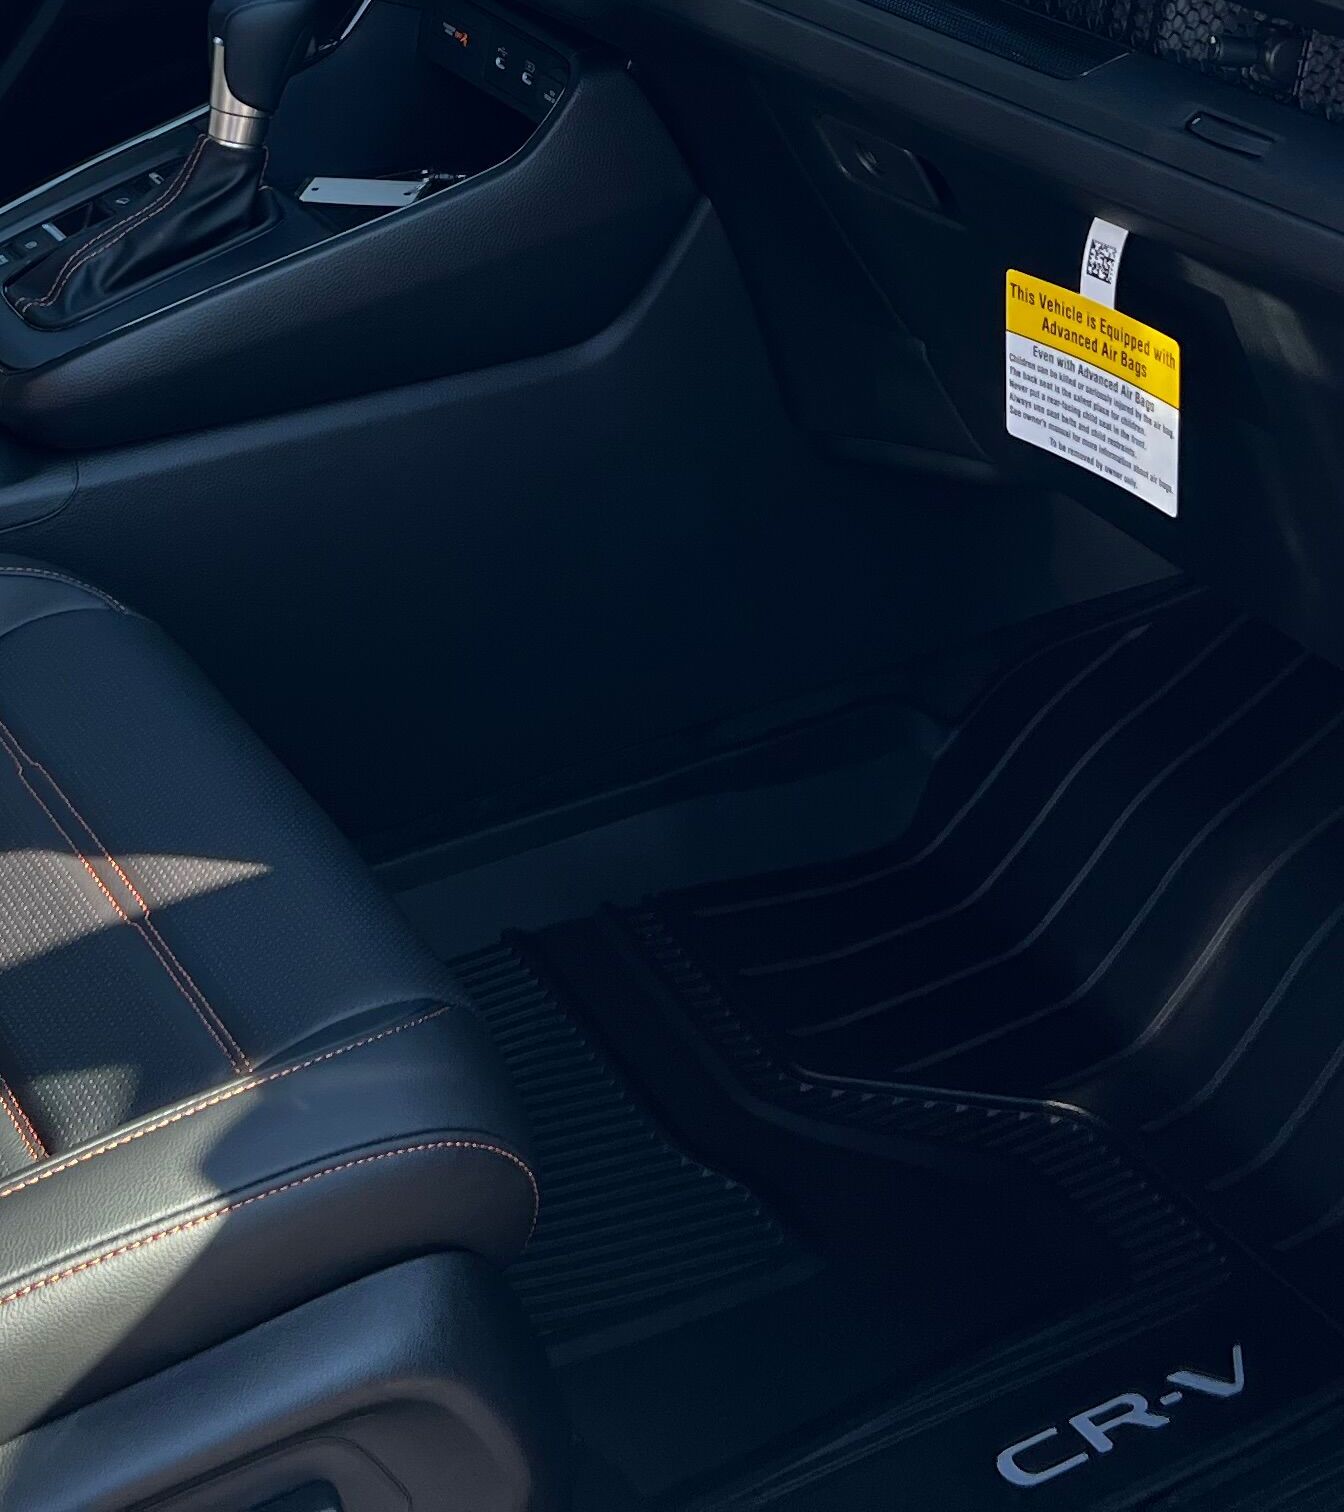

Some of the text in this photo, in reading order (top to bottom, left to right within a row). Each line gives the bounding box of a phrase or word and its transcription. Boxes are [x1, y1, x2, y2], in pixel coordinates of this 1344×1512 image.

[1010, 282, 1176, 370] This Vehicle is Equipped with
[1042, 317, 1147, 378] Advanced Air Bags
[1032, 345, 1154, 413] Even with Advanced Air Bags
[997, 1344, 1244, 1486] CR-V
